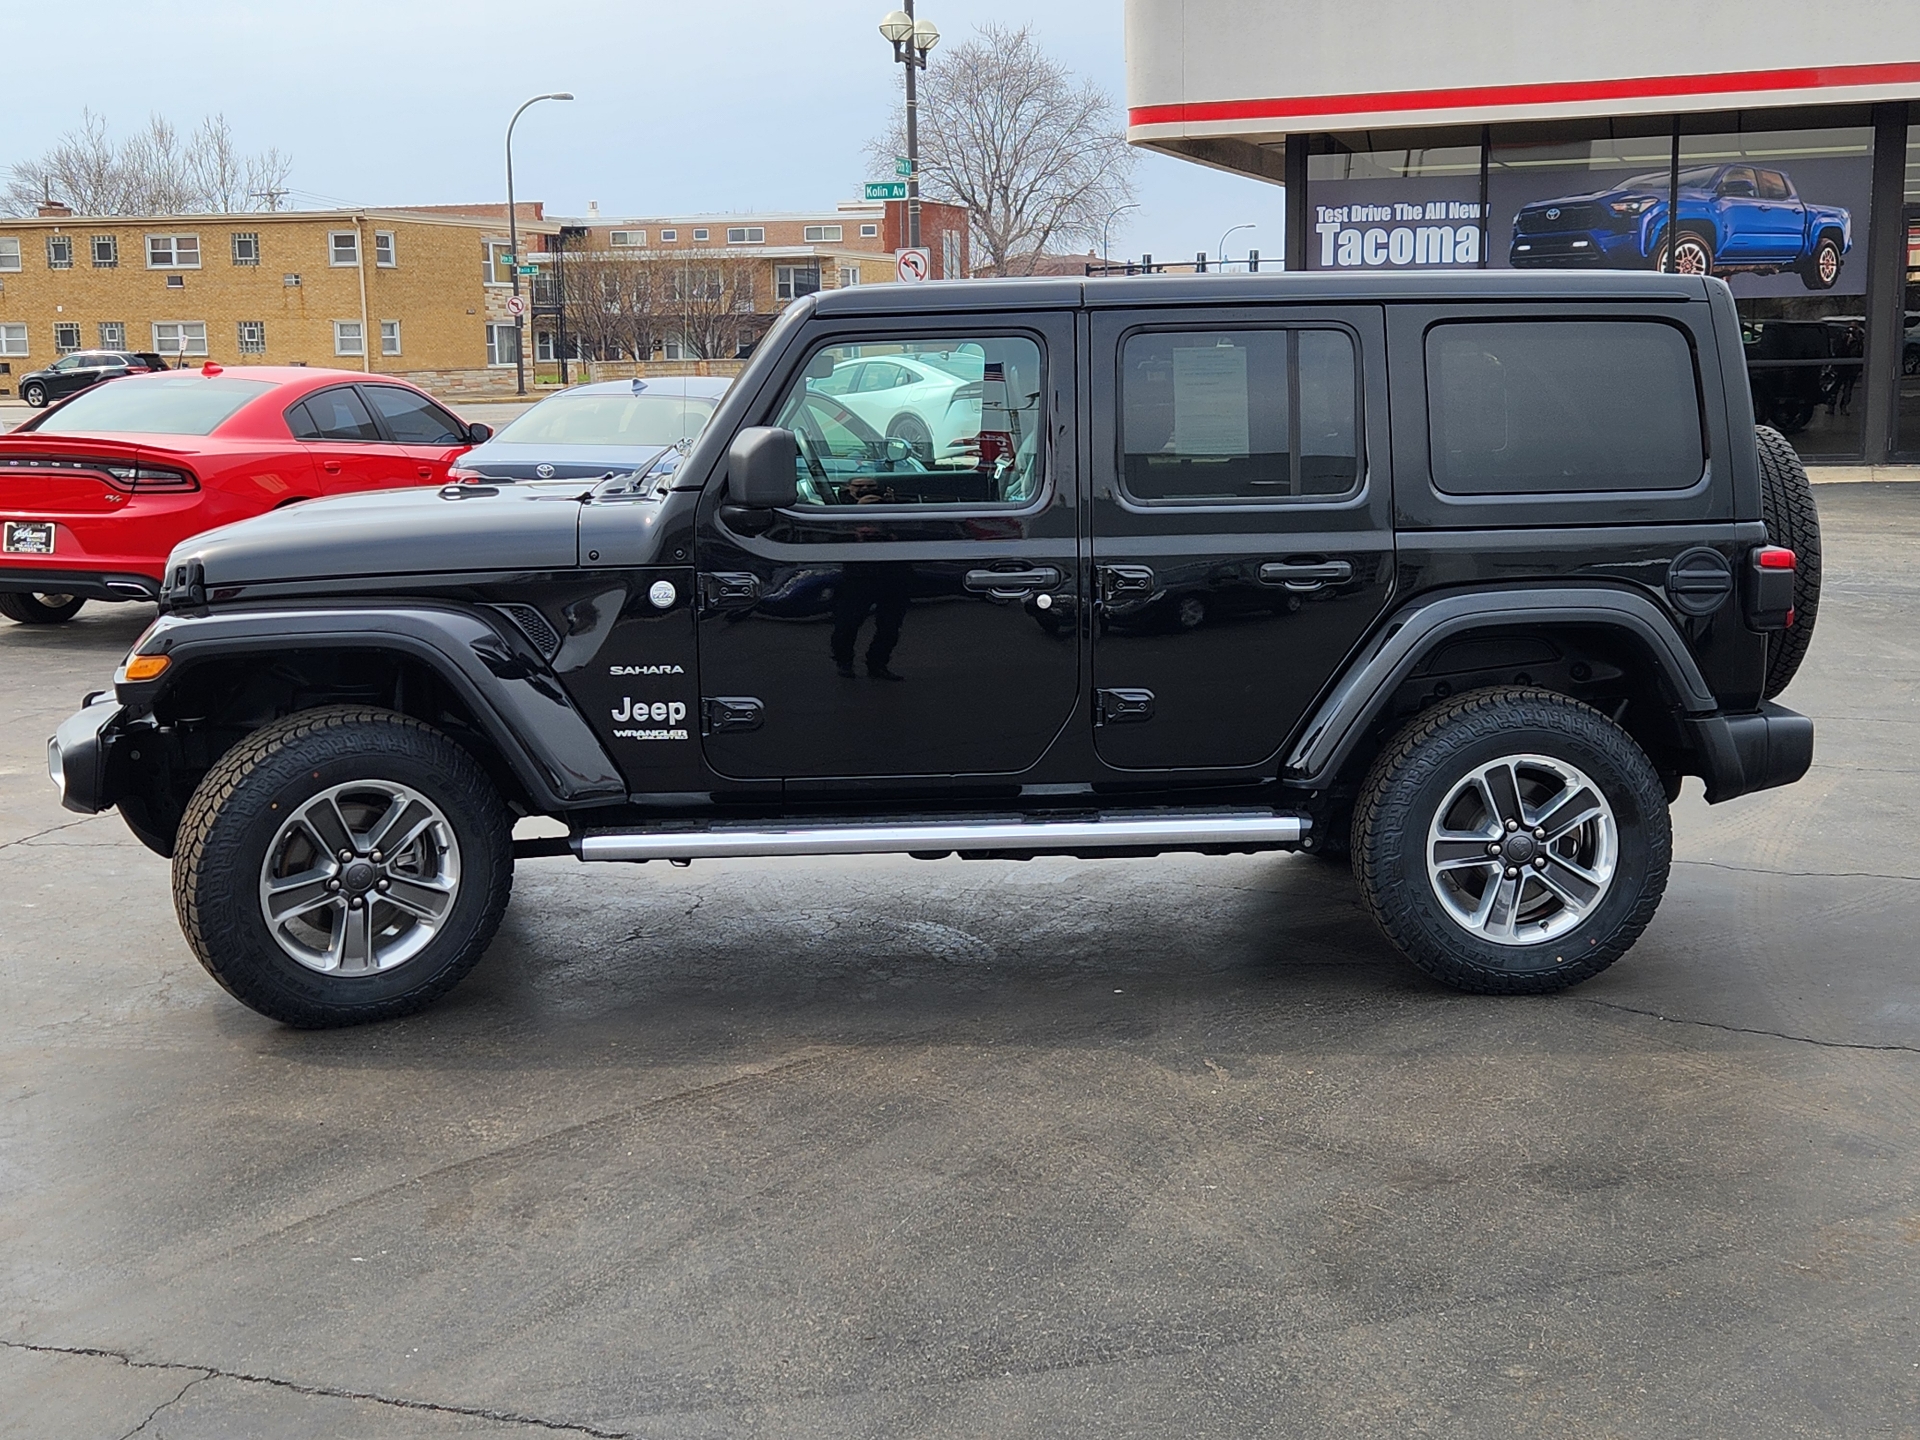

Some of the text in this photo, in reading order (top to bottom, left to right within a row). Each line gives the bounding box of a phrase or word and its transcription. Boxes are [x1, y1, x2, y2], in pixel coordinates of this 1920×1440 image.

[866, 185, 904, 198] Kolin Av
[1316, 202, 1490, 223] Test Drive The All New
[1316, 222, 1488, 267] Tacoma
[609, 665, 685, 676] SAHARA
[611, 696, 687, 726] Jeep
[612, 729, 688, 738] WRANGLER
